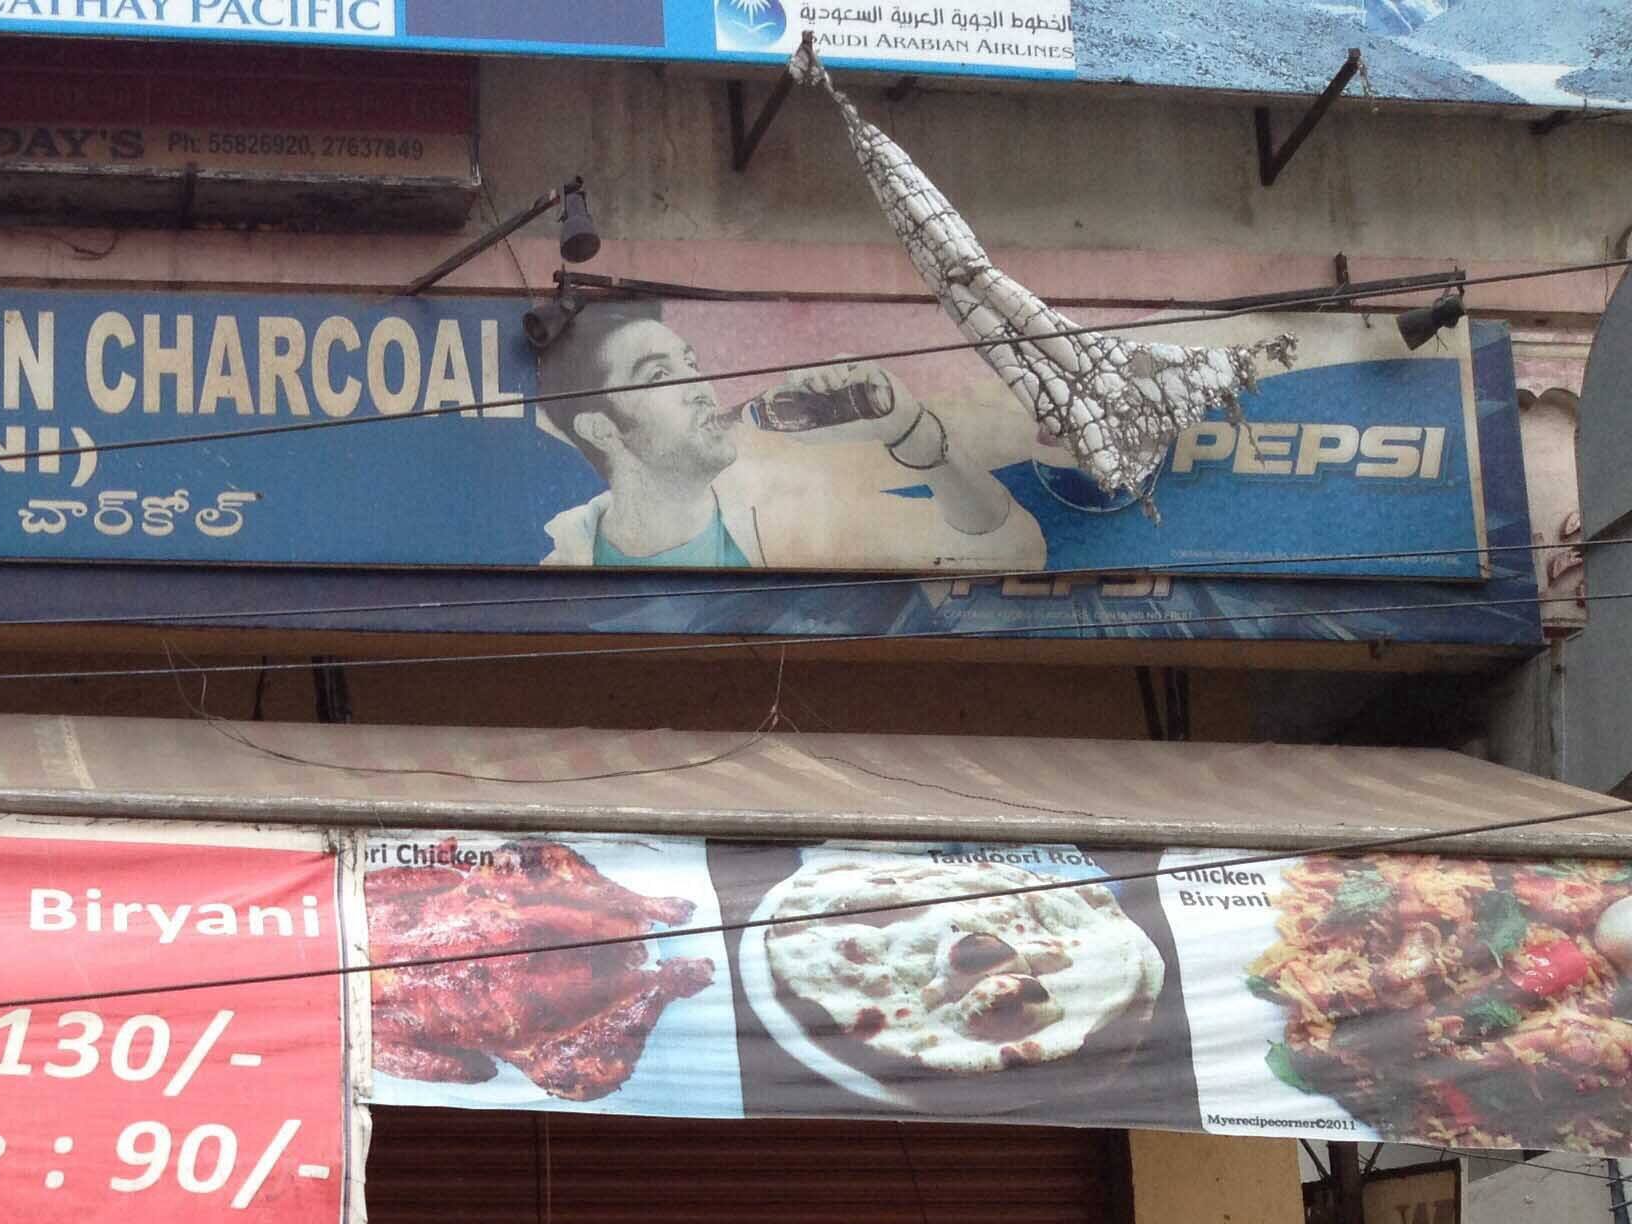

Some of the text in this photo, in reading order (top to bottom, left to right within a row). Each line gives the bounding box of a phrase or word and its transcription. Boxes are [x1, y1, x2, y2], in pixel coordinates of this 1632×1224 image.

[191, 0, 381, 30] PACIFIC
[799, 2, 1073, 35] الخطوط الجوية العربية السعودية
[813, 33, 1075, 59] AUDI ARABIAN AIRLINES
[85, 311, 525, 421] CHARCOAL
[1170, 421, 1448, 480] PEPSI
[365, 843, 494, 867] ri Chicken
[927, 848, 1041, 866] Tandoori
[1171, 863, 1266, 887] Chicken
[1179, 889, 1273, 911] Biryani
[29, 888, 323, 945] Biryani
[110, 1119, 331, 1210] 90/-
